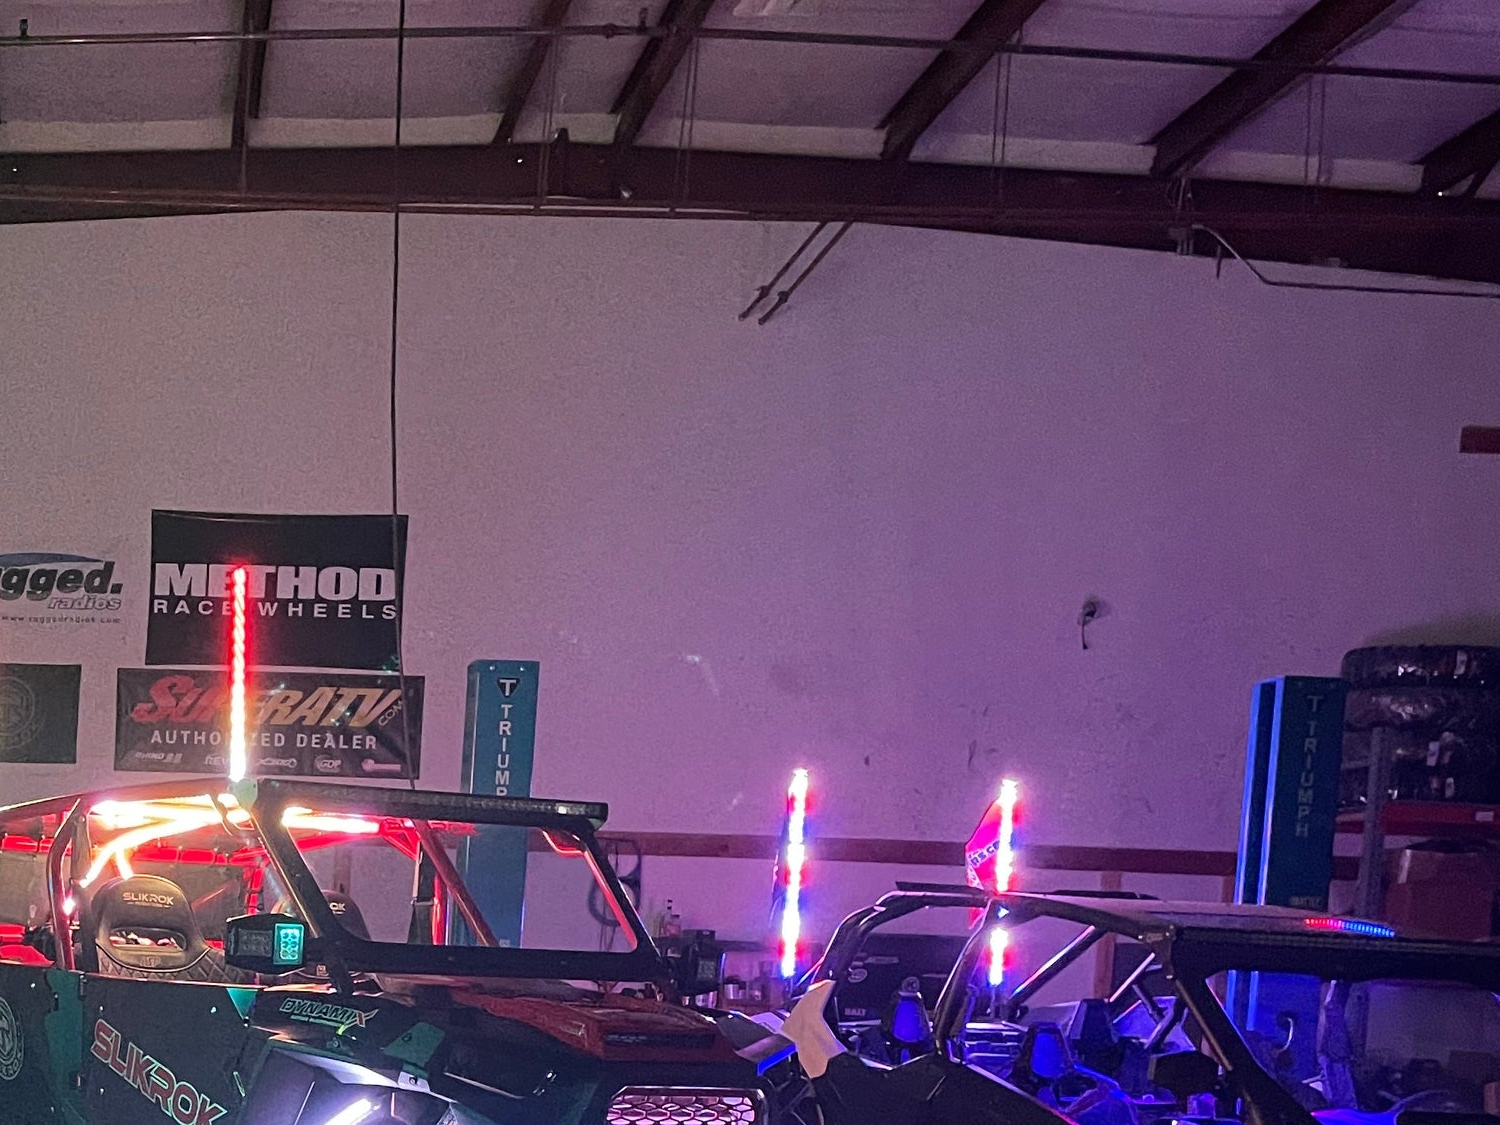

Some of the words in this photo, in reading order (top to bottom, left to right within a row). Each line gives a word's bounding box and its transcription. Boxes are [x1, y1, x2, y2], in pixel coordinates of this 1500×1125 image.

[154, 563, 396, 600] METHOD
[48, 595, 121, 610] radios
[153, 599, 234, 616] RACE
[258, 602, 397, 619] WHEELS
[151, 730, 285, 747] AUTHOZED
[297, 732, 377, 750] DEALER
[495, 704, 513, 796] TRIUMP
[122, 892, 174, 905] SLIKROK
